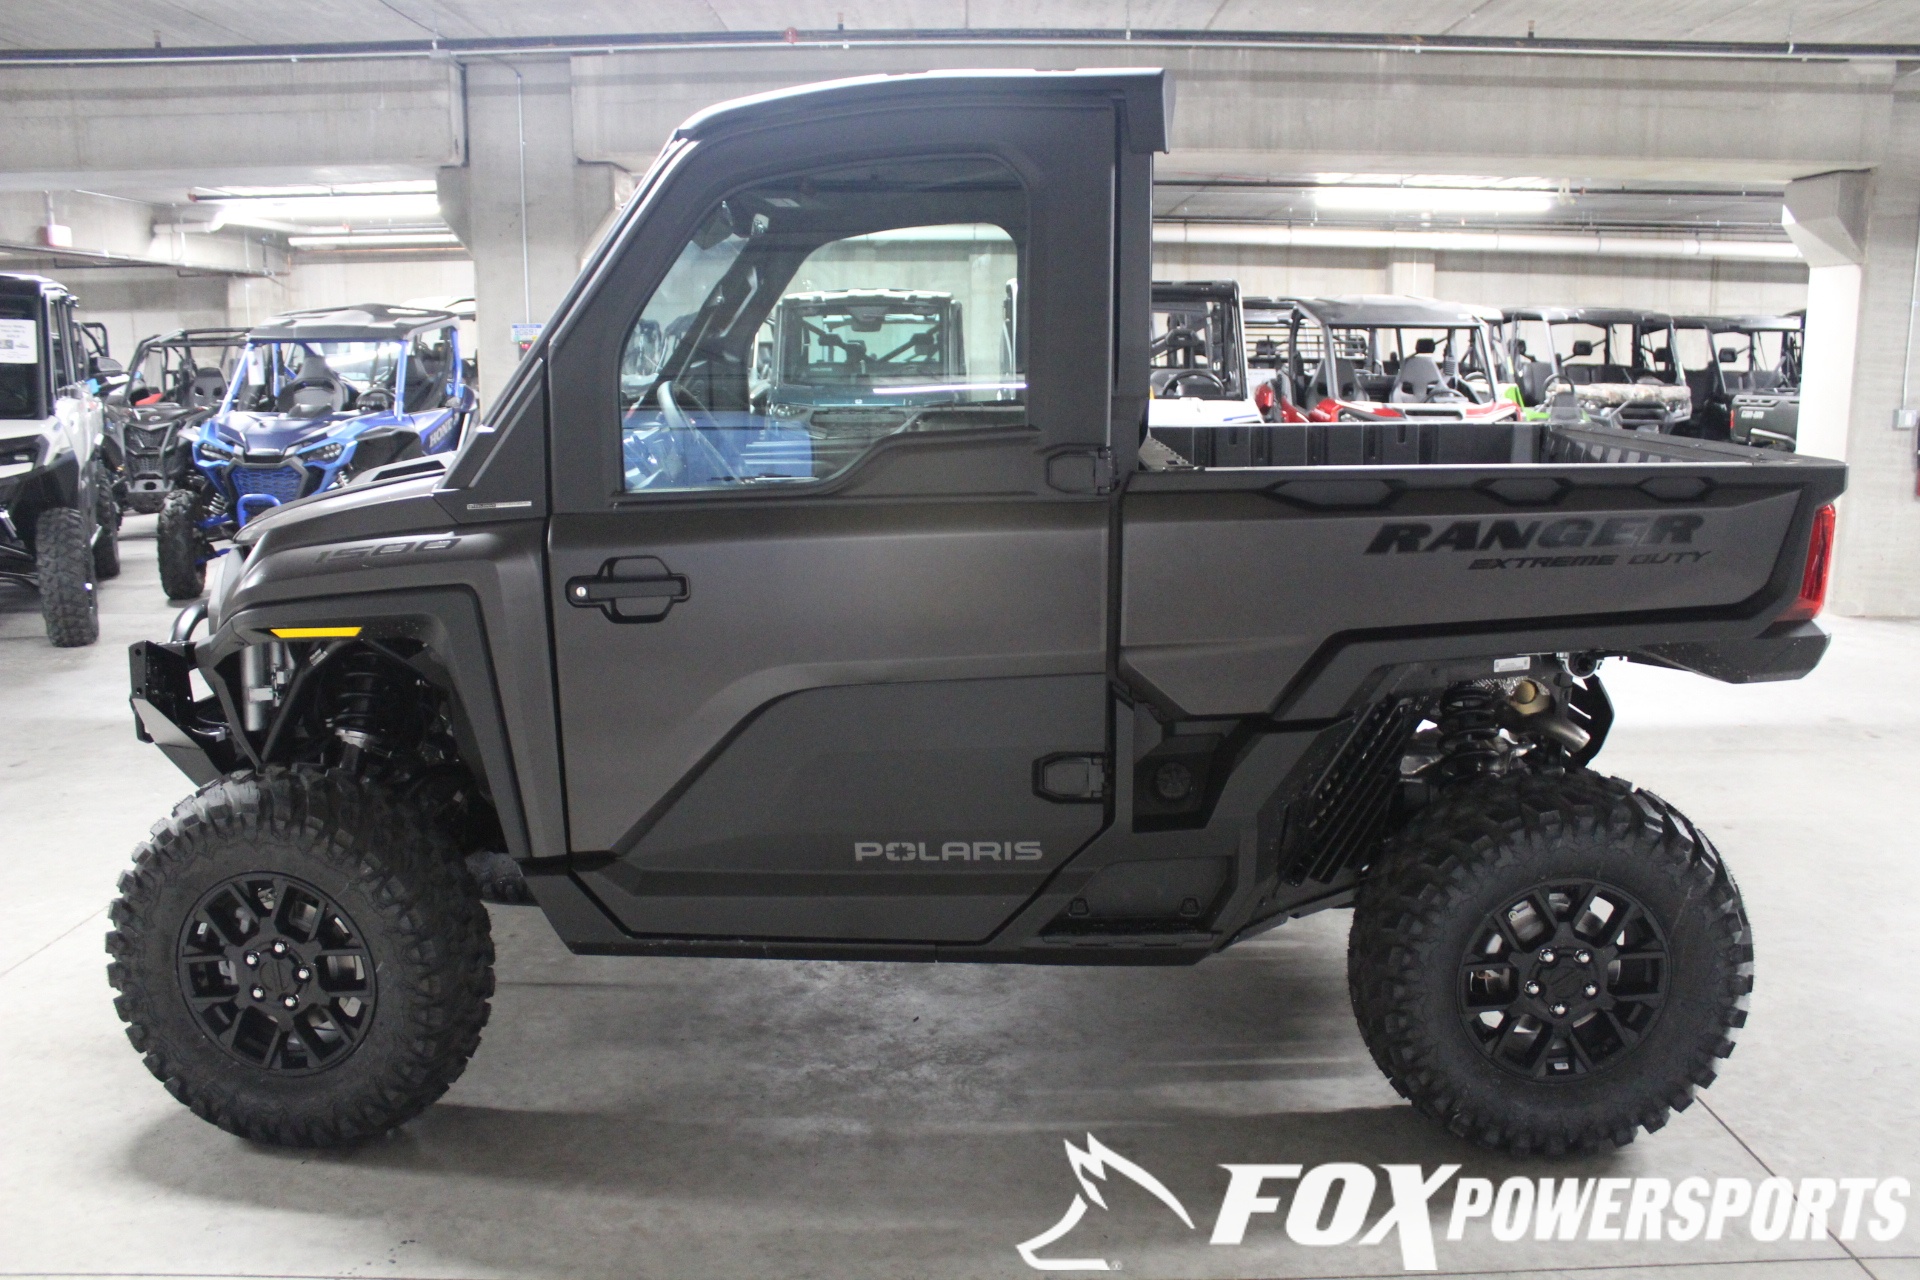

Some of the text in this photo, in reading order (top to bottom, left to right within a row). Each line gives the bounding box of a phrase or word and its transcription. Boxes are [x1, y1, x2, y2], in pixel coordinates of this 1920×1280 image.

[1363, 514, 1706, 556] RANGER
[314, 537, 462, 564] 1500
[1468, 550, 1712, 571] EXTREME DUTY
[854, 841, 1043, 862] POLARIS
